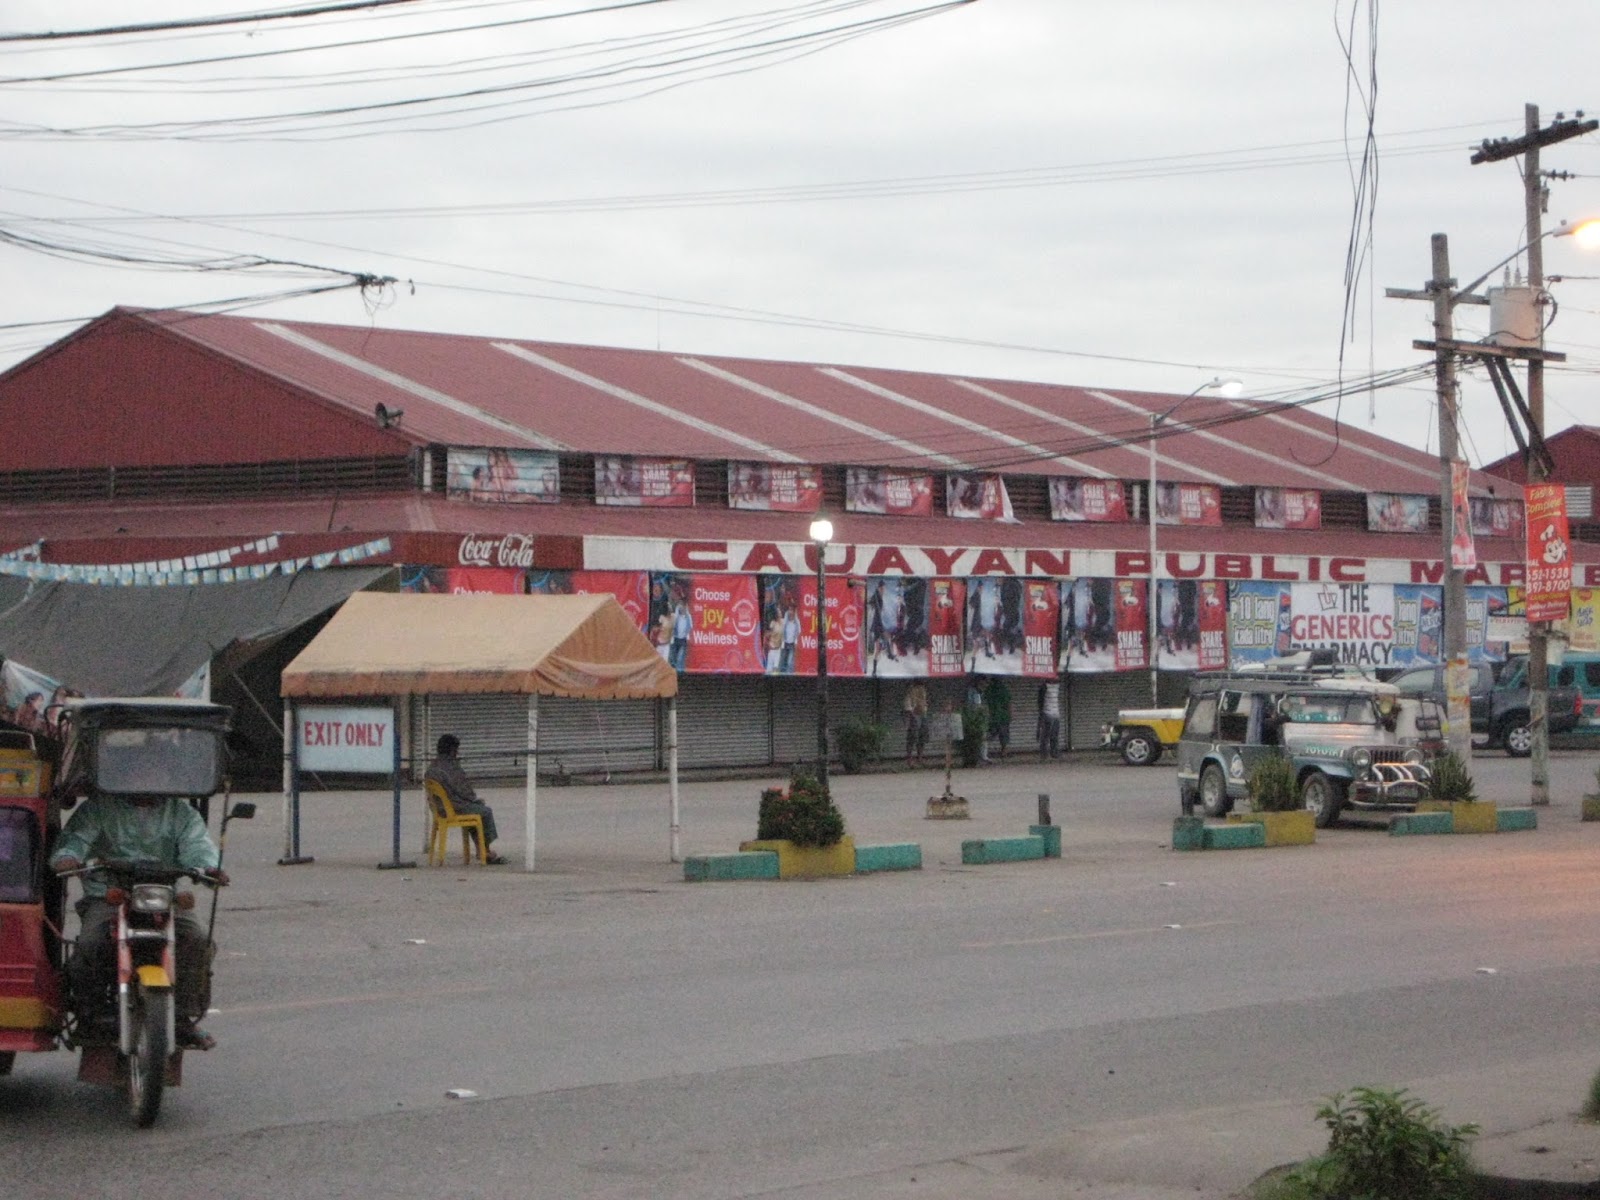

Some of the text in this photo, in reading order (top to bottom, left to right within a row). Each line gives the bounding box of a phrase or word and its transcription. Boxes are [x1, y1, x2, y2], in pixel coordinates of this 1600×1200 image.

[458, 533, 534, 567] Coca-Cola
[671, 541, 1071, 576] CAUAYAN
[1115, 551, 1366, 582] PUBLIC
[695, 588, 730, 600] Choose
[1340, 584, 1370, 613] THE
[702, 604, 724, 629] joy
[1291, 615, 1393, 641] GENERICS
[693, 631, 738, 645] Wellness
[931, 634, 960, 654] SHARE
[1026, 636, 1053, 655] SHARE
[1292, 642, 1393, 665] RMACY
[304, 721, 386, 747] EXIT ONLY
